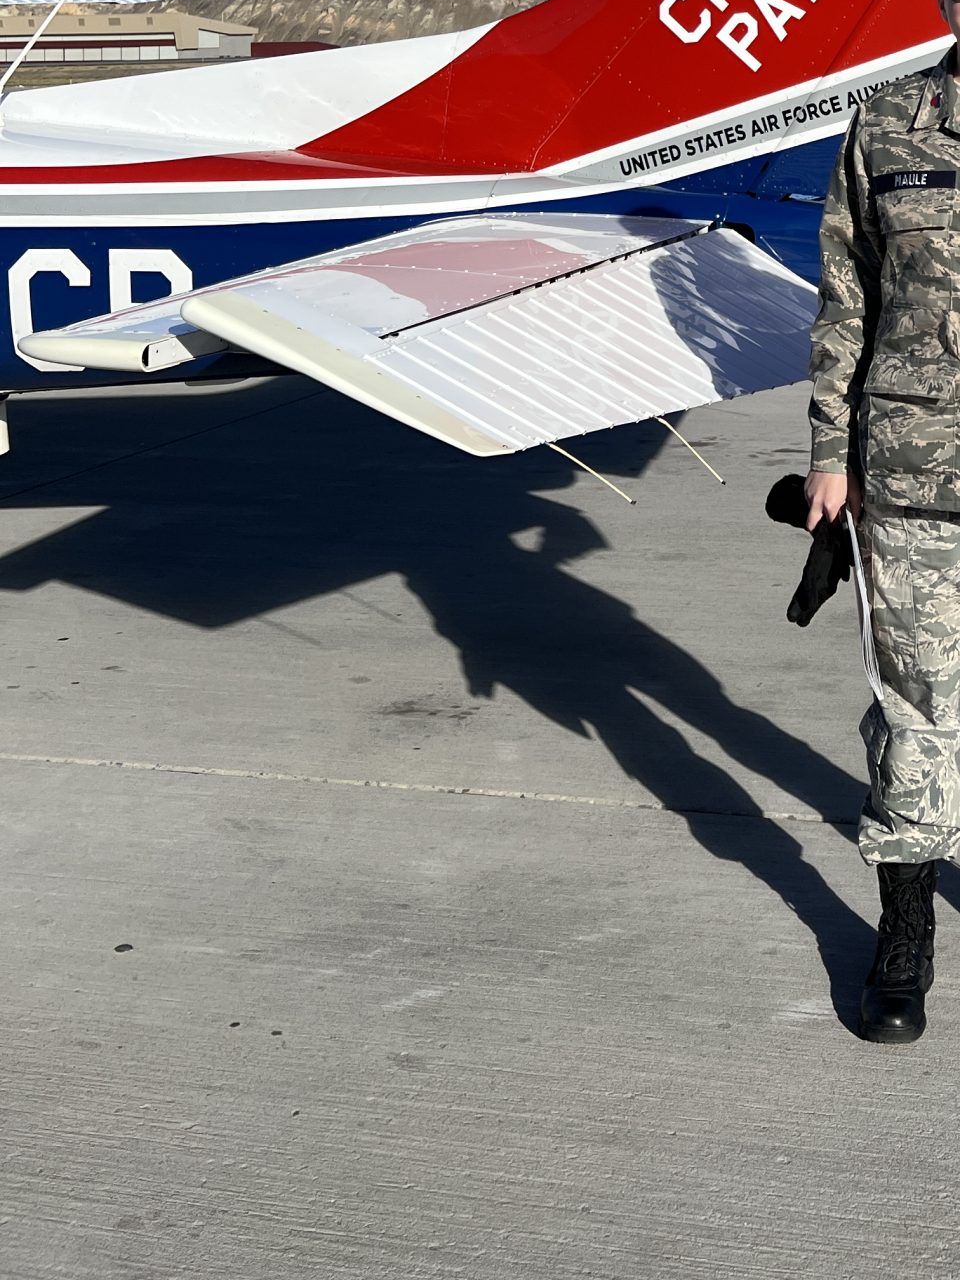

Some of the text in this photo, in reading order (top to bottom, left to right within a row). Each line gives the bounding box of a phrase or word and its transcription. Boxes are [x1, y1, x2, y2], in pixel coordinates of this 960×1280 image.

[619, 95, 843, 176] UNITED STATES AIR FORCE
